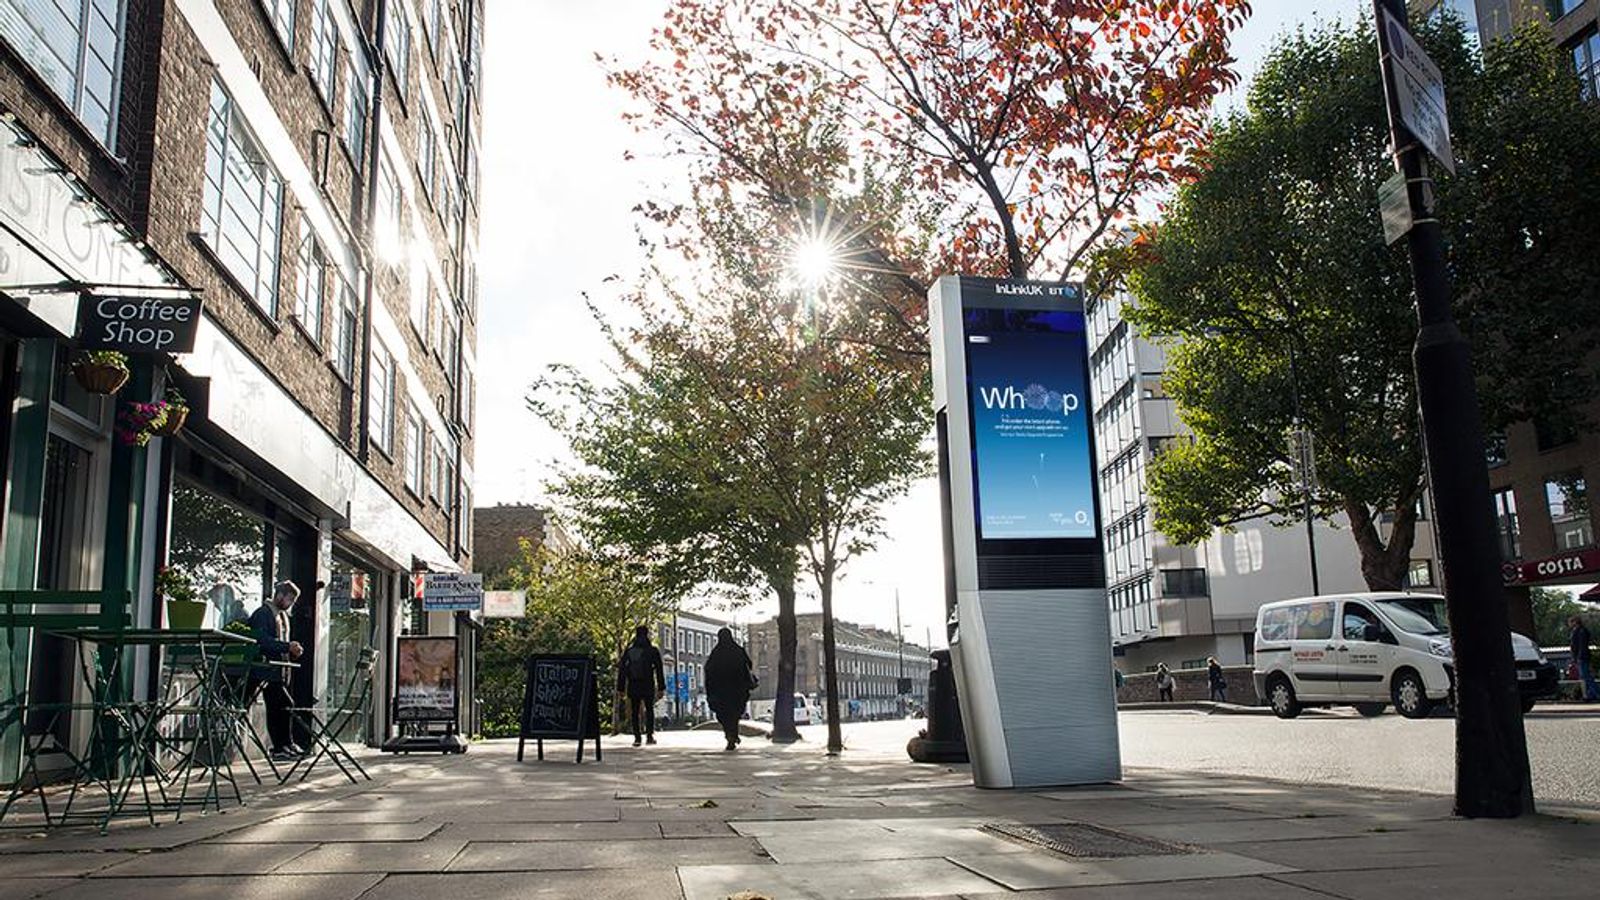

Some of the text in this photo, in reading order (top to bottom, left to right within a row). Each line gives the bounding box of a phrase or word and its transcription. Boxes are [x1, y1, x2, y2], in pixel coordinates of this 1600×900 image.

[995, 283, 1044, 297] InLinkUK
[96, 298, 191, 322] Coffee
[102, 322, 175, 350] Shop
[980, 384, 1079, 416] Whoop
[1537, 557, 1584, 575] COSTA
